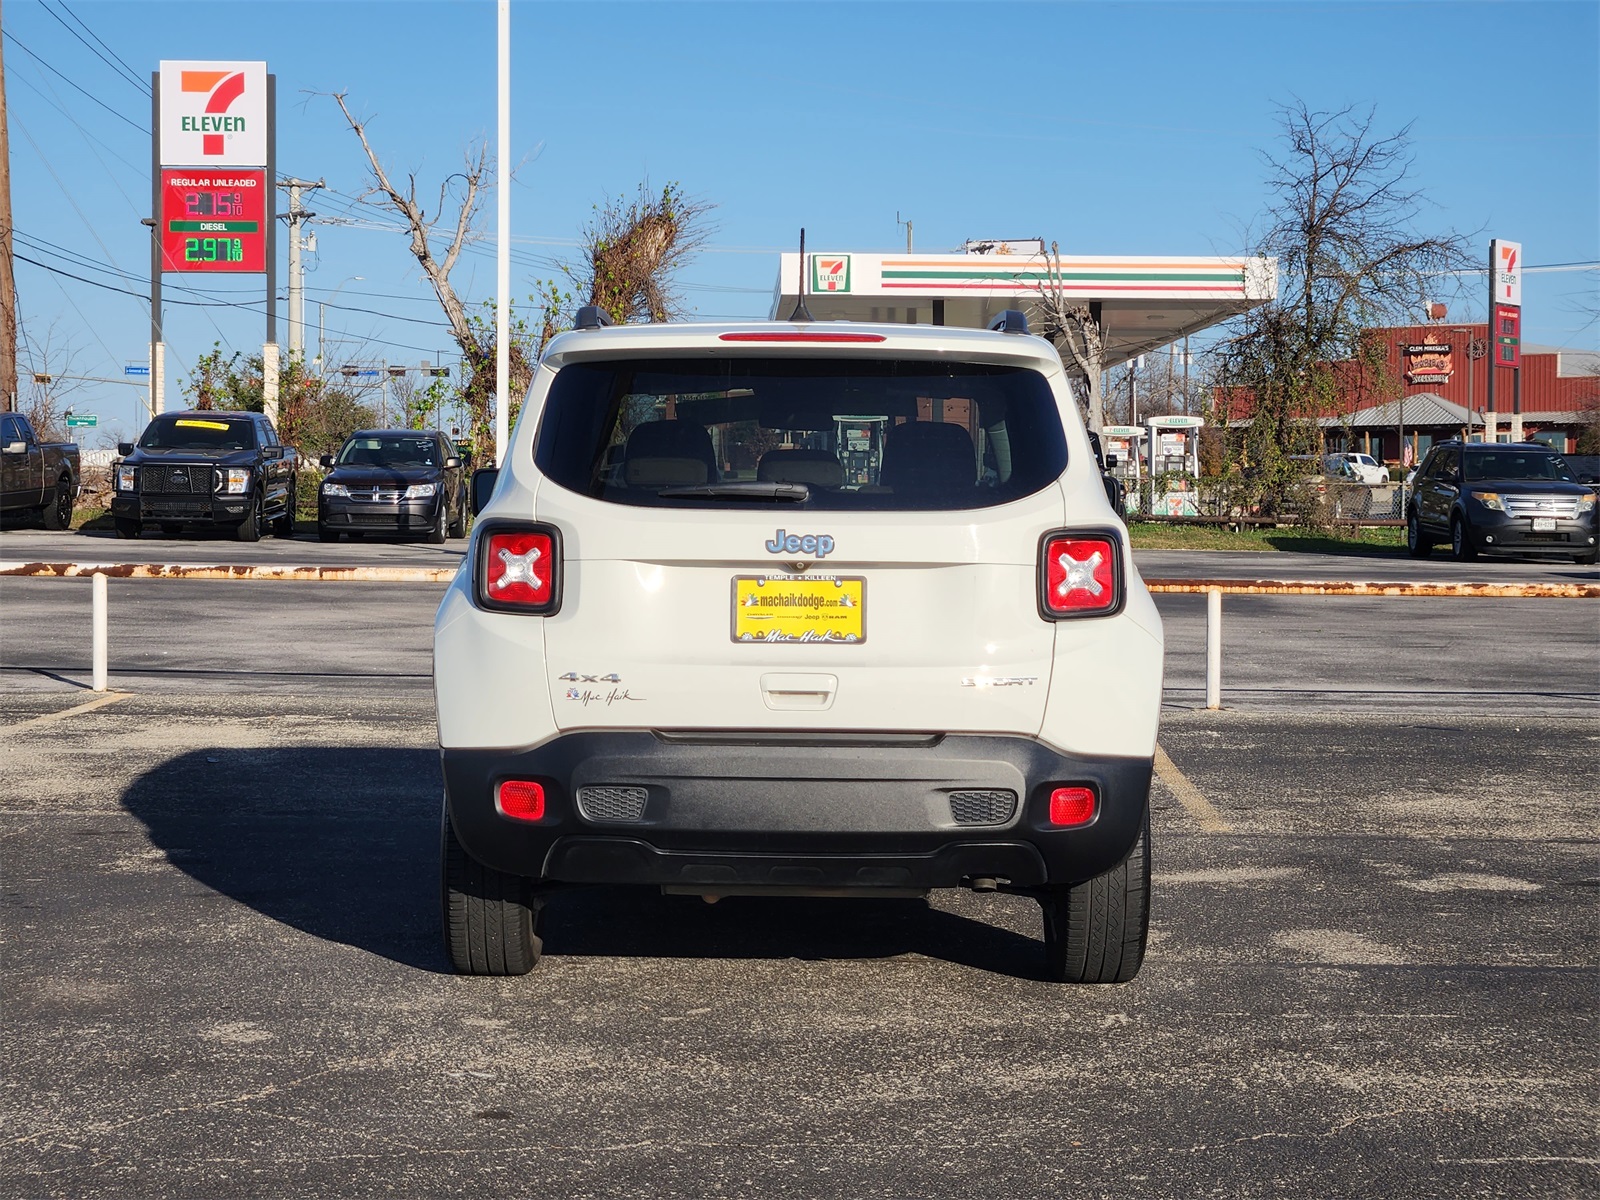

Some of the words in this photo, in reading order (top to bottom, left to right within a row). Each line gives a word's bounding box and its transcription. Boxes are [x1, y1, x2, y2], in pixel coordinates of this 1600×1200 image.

[171, 178, 210, 187] REGULAR
[212, 179, 257, 187] UNLEADED
[200, 222, 227, 231] DIESEL
[185, 237, 231, 261] 2.97
[765, 529, 835, 558] Jeep
[760, 593, 838, 610] machaikdodge.com
[764, 629, 794, 643] Mac
[558, 672, 622, 684] 4x4
